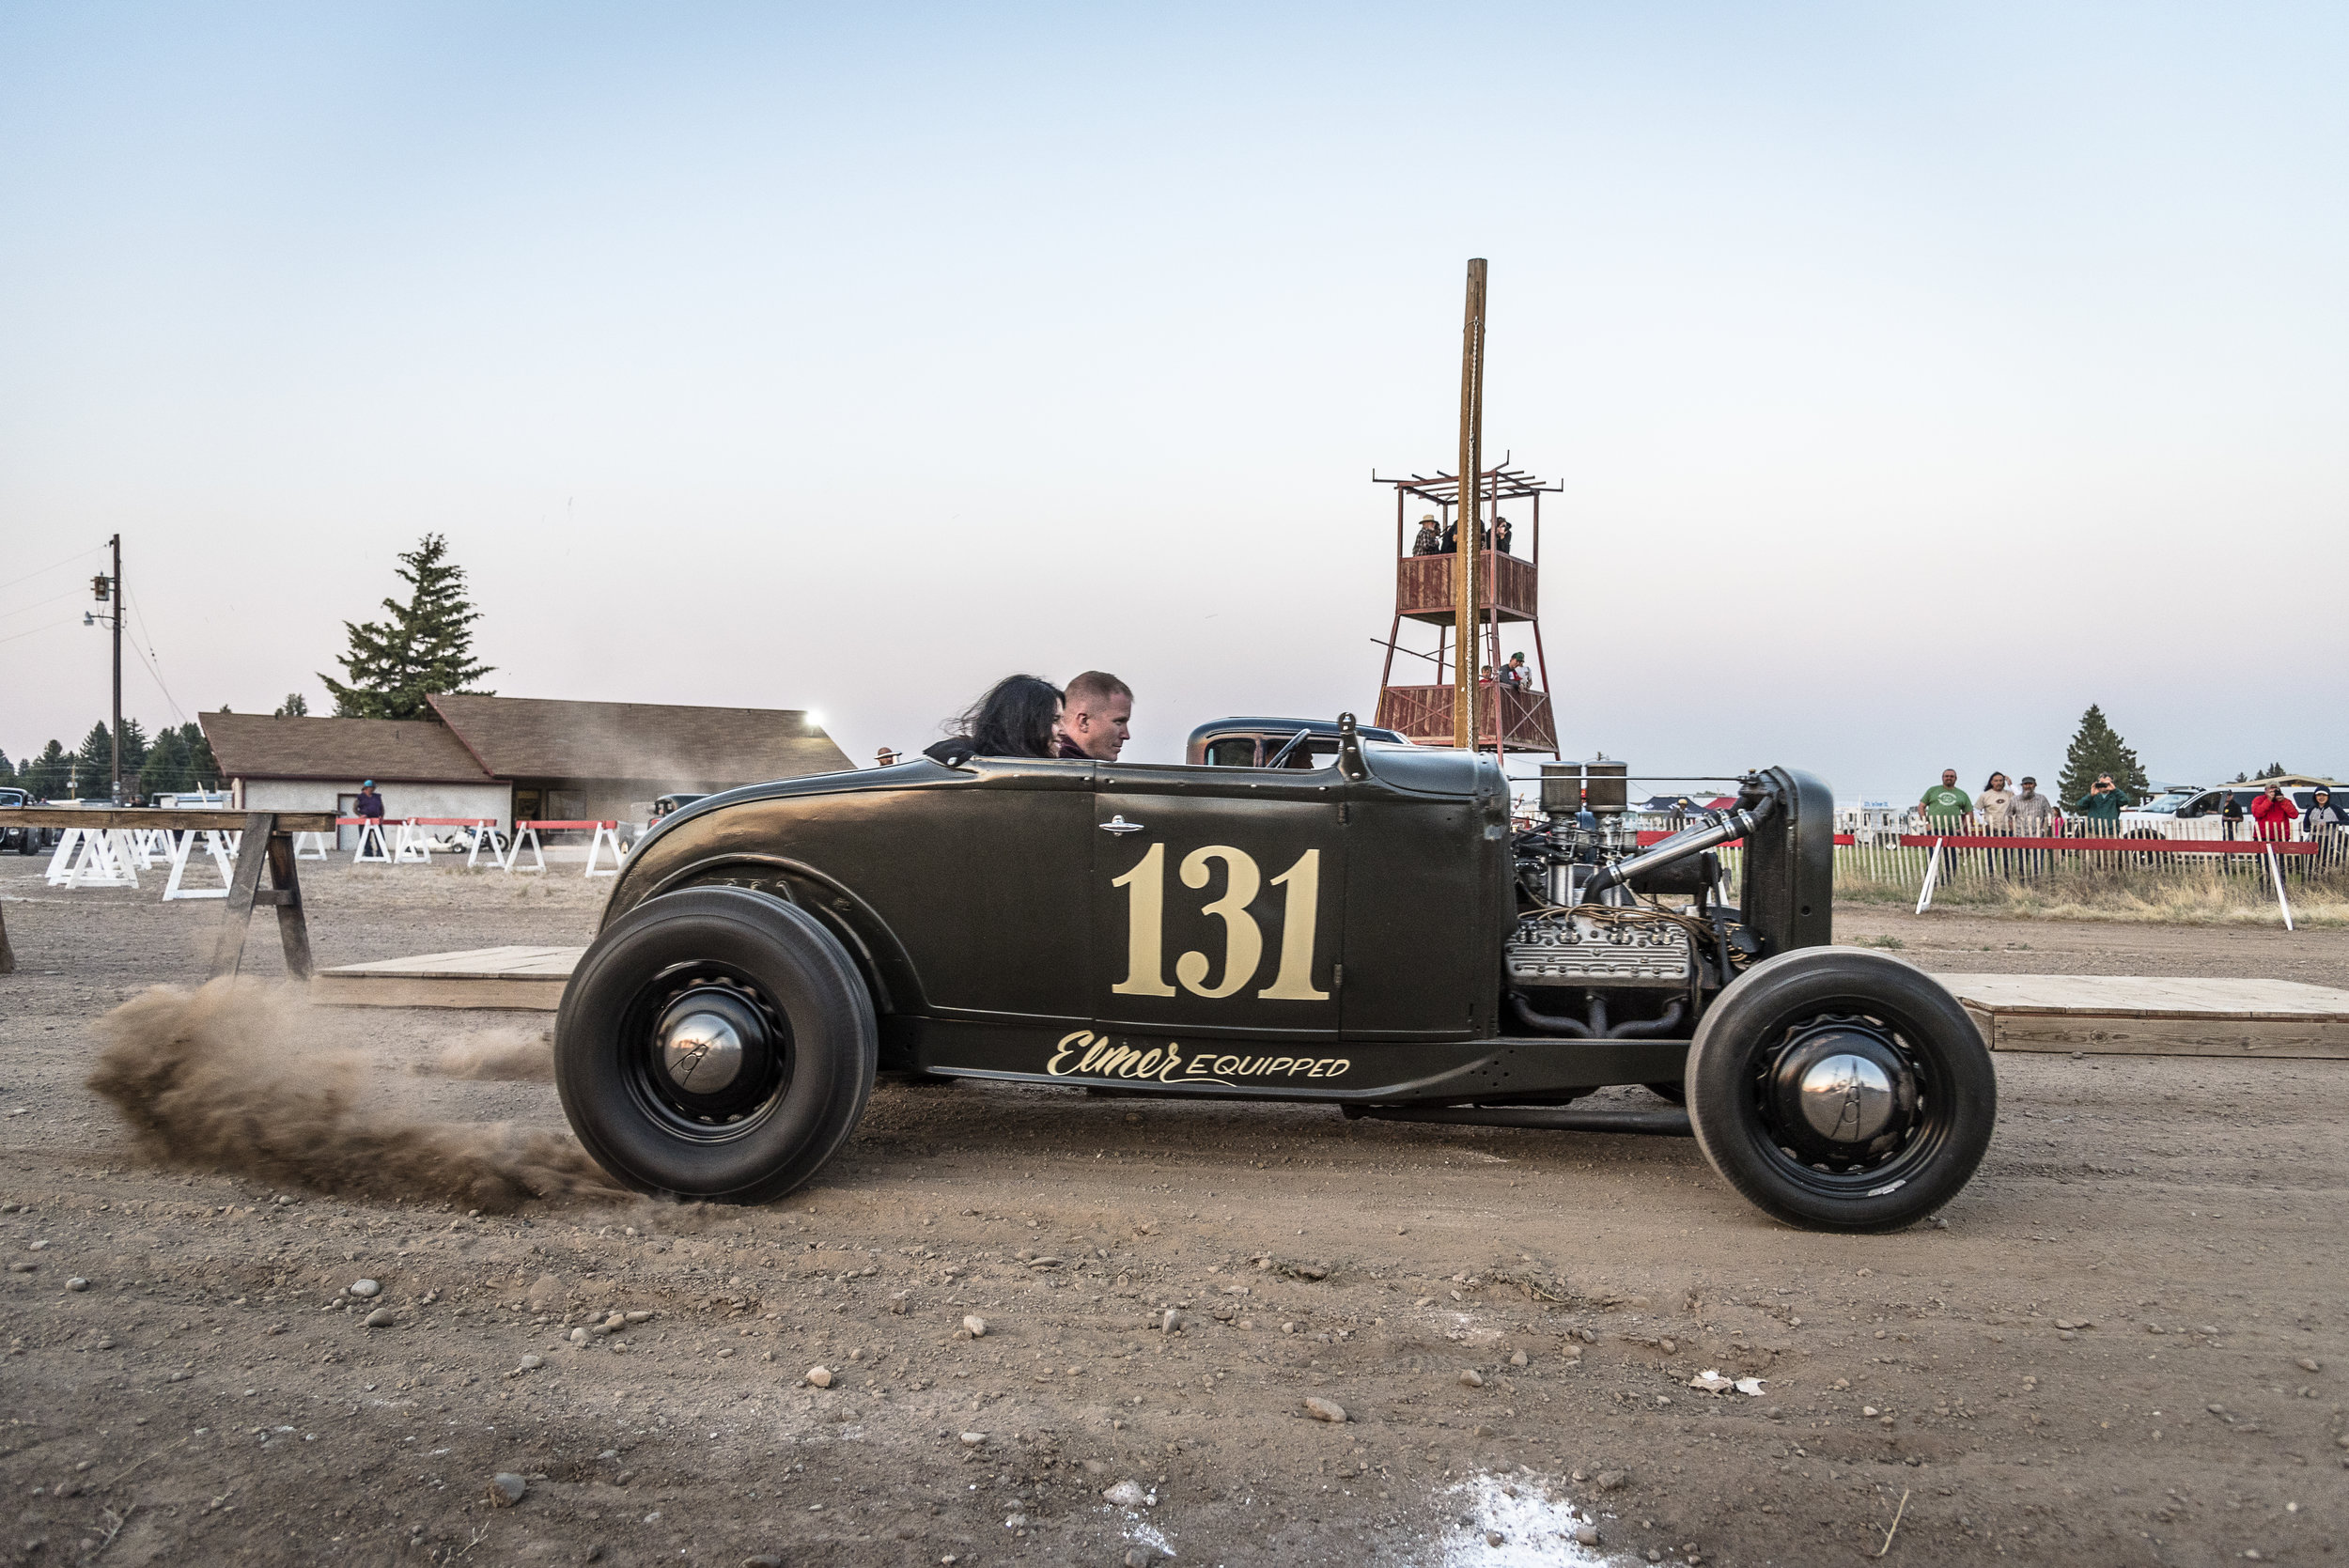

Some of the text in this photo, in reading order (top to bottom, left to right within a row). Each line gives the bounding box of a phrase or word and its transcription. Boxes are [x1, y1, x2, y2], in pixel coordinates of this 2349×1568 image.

[1112, 843, 1330, 1000] 131
[1047, 1030, 1350, 1087] Elmer EQUIPPED
